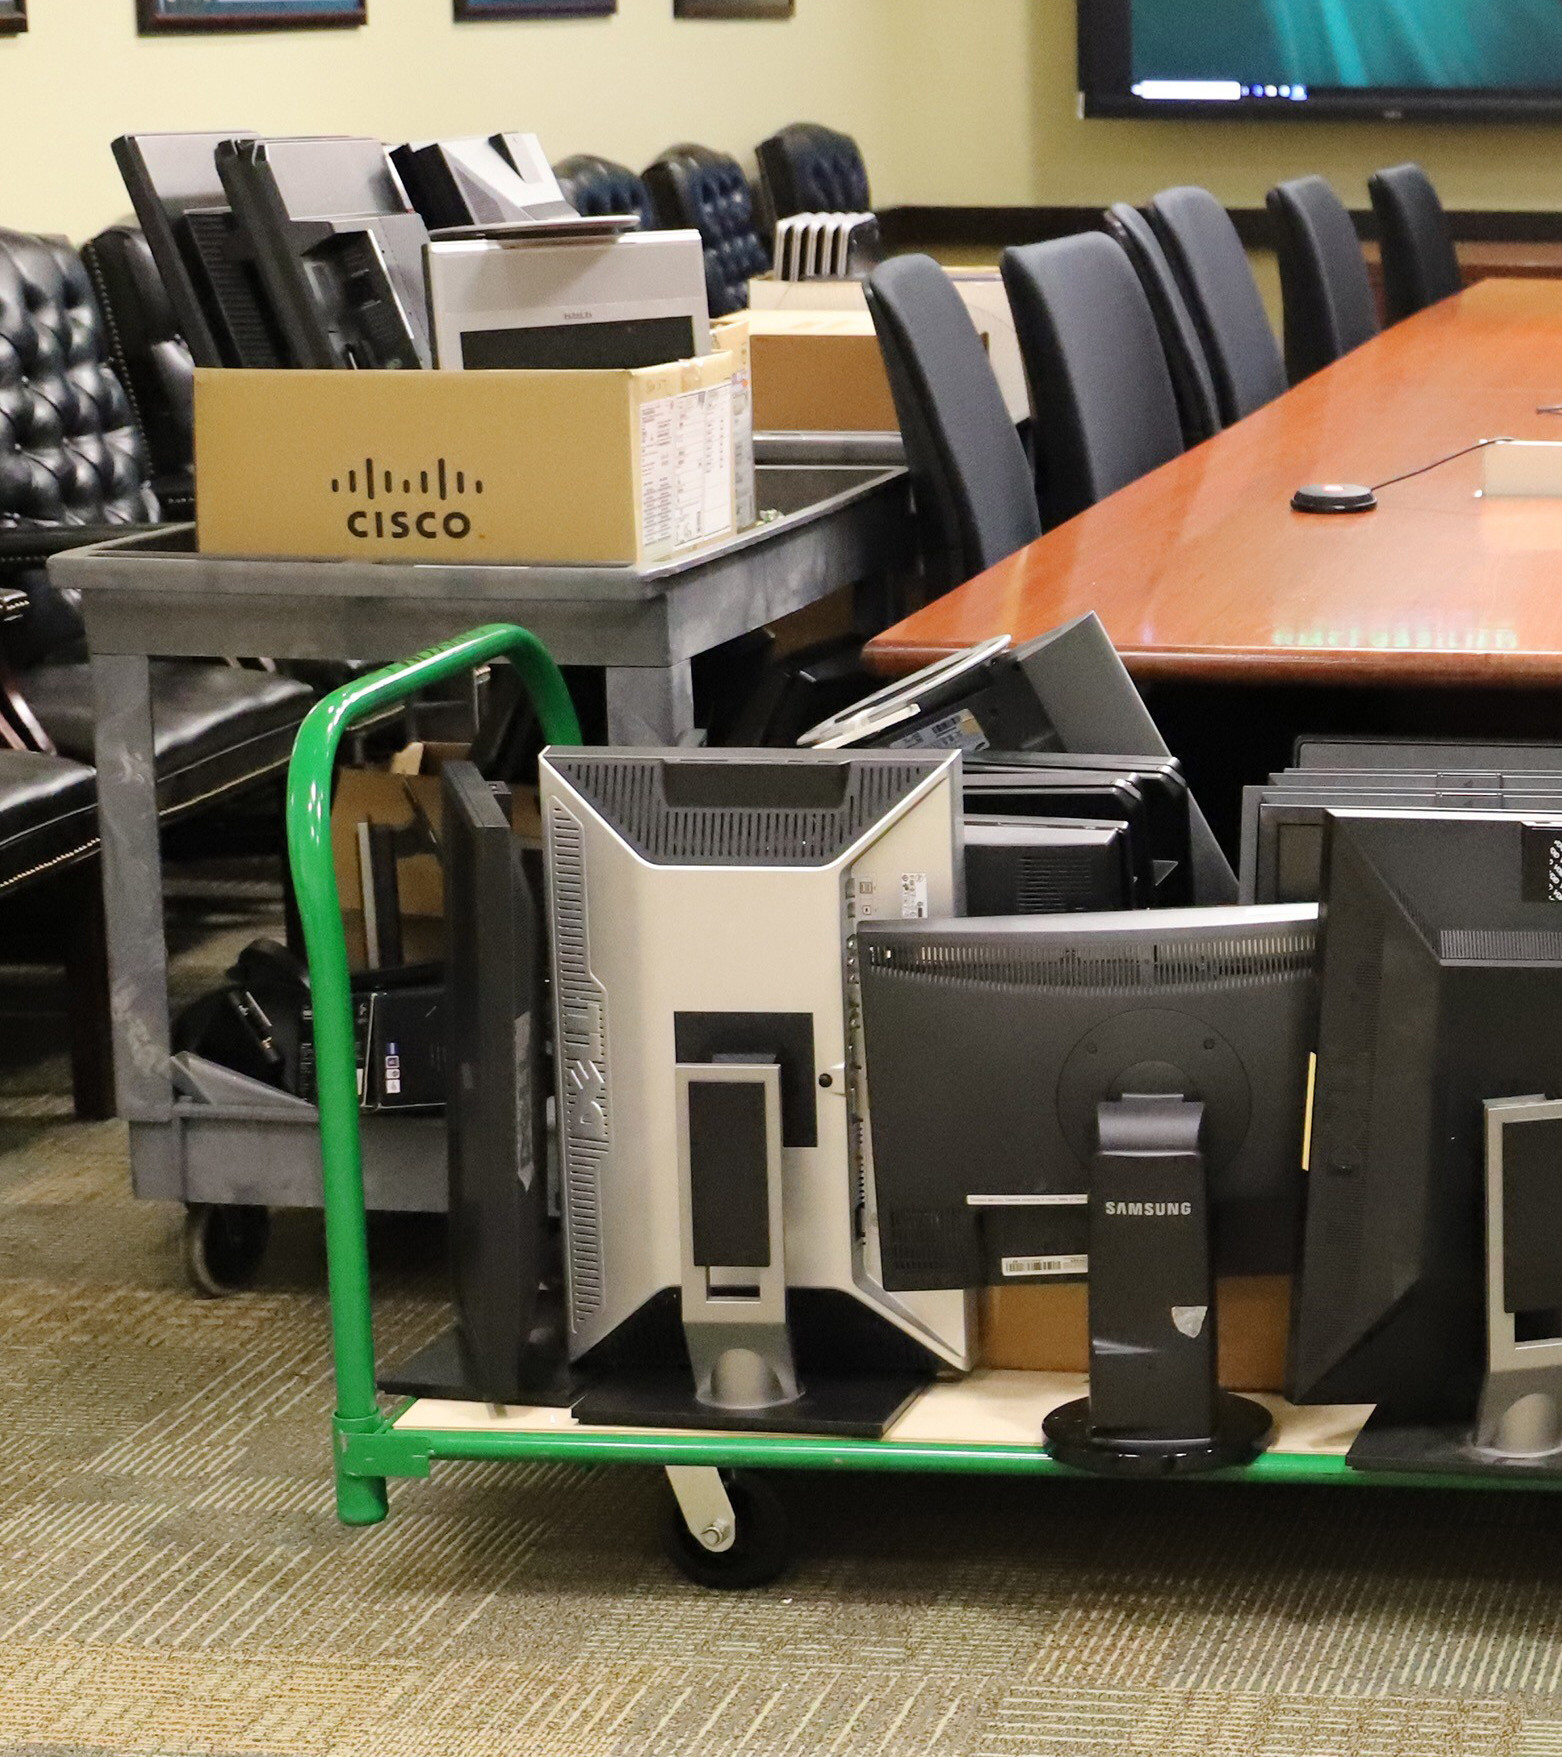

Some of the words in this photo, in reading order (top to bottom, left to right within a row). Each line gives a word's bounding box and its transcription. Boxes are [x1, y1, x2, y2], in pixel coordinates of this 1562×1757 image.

[347, 511, 471, 539] CISCO
[566, 1003, 606, 1137] DELL
[1105, 1201, 1192, 1216] SAMSUNG
